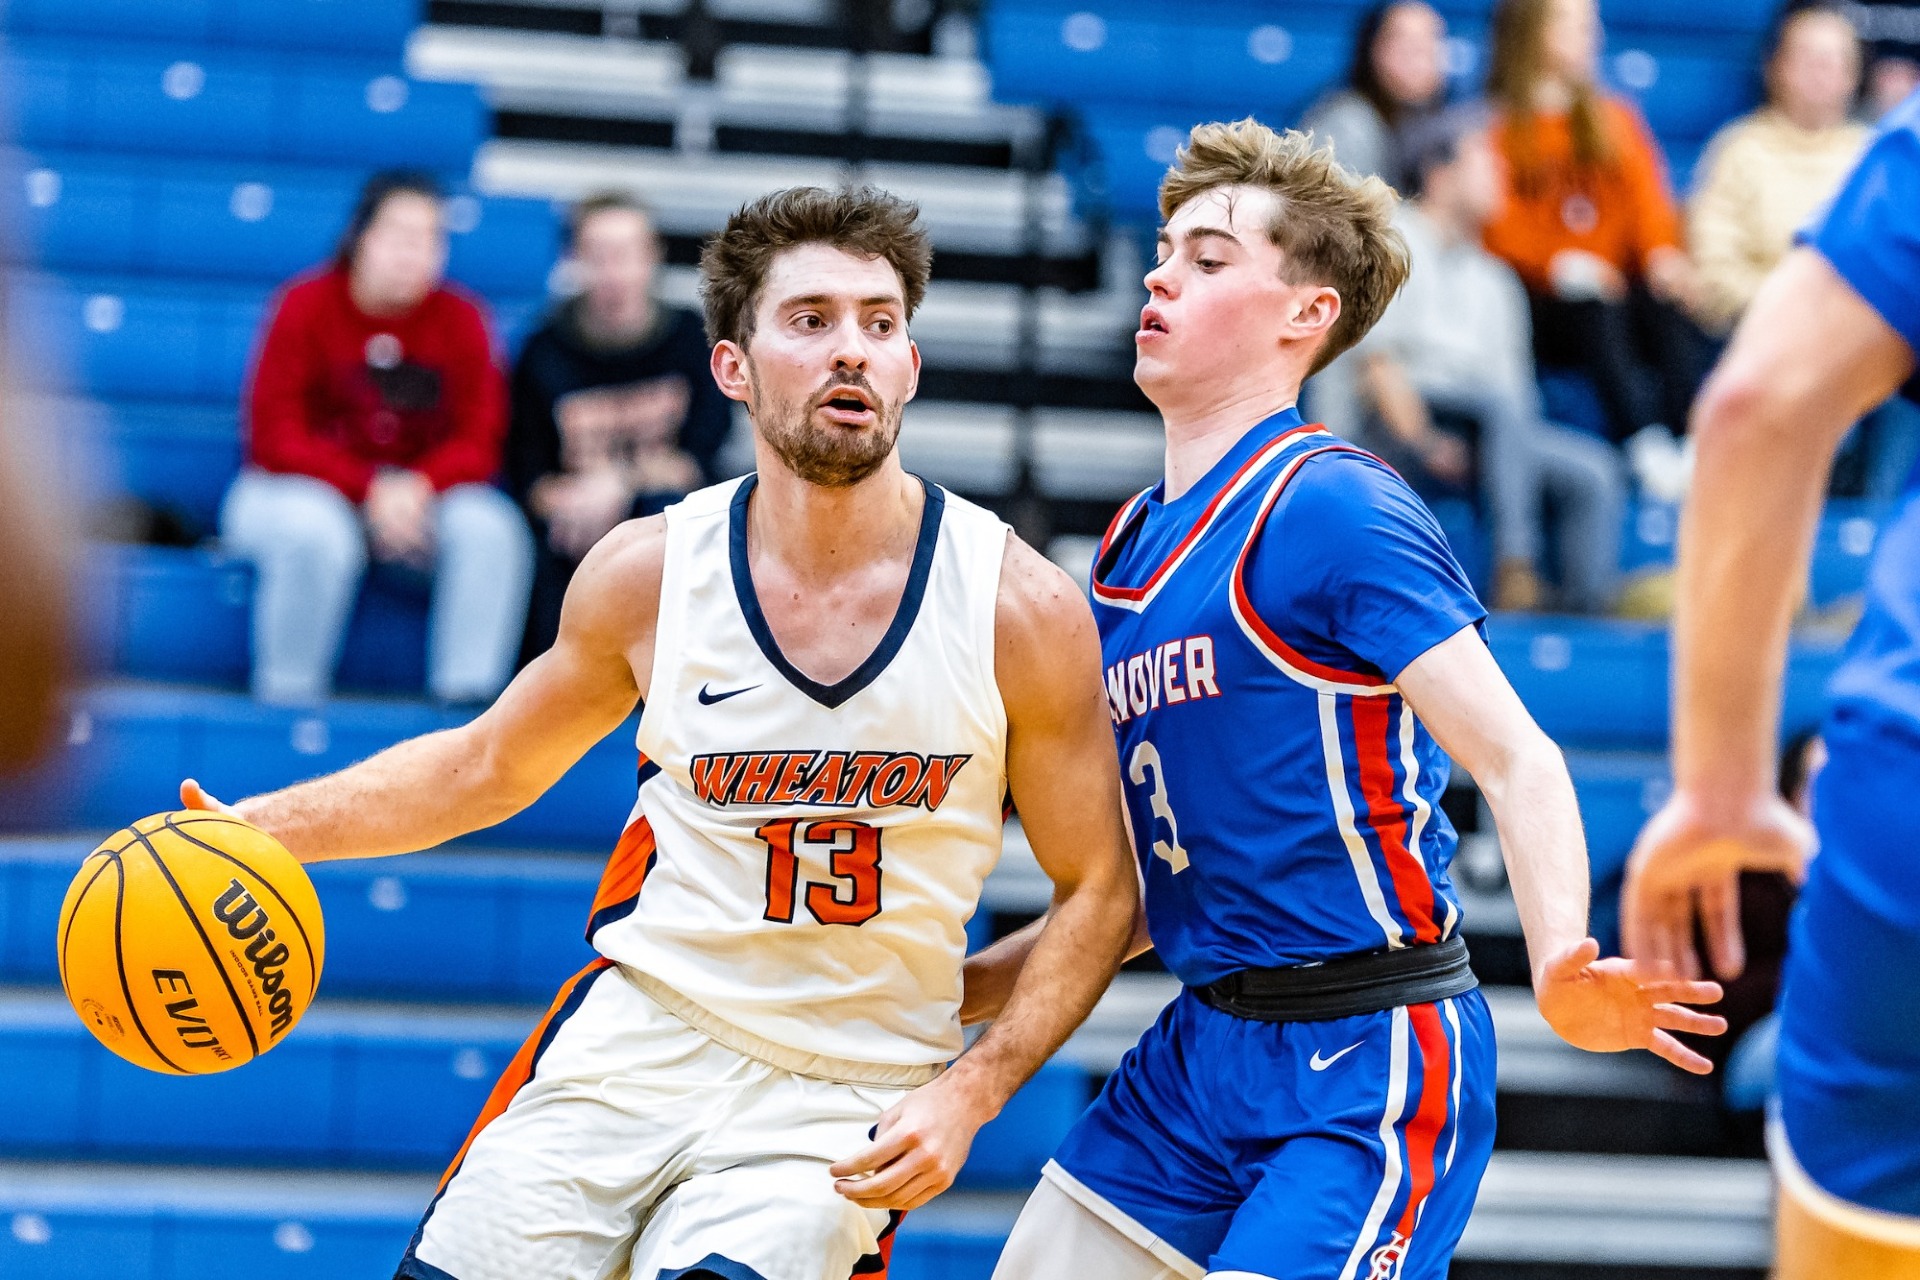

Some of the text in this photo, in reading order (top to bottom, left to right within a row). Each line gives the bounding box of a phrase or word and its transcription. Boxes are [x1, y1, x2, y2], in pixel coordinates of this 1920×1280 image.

[690, 750, 974, 812] WHEATON
[1129, 740, 1190, 875] 3
[755, 817, 883, 927] 13
[212, 878, 293, 1039] Wilson
[229, 949, 248, 978] INDOOR
[211, 1046, 233, 1061] NXT
